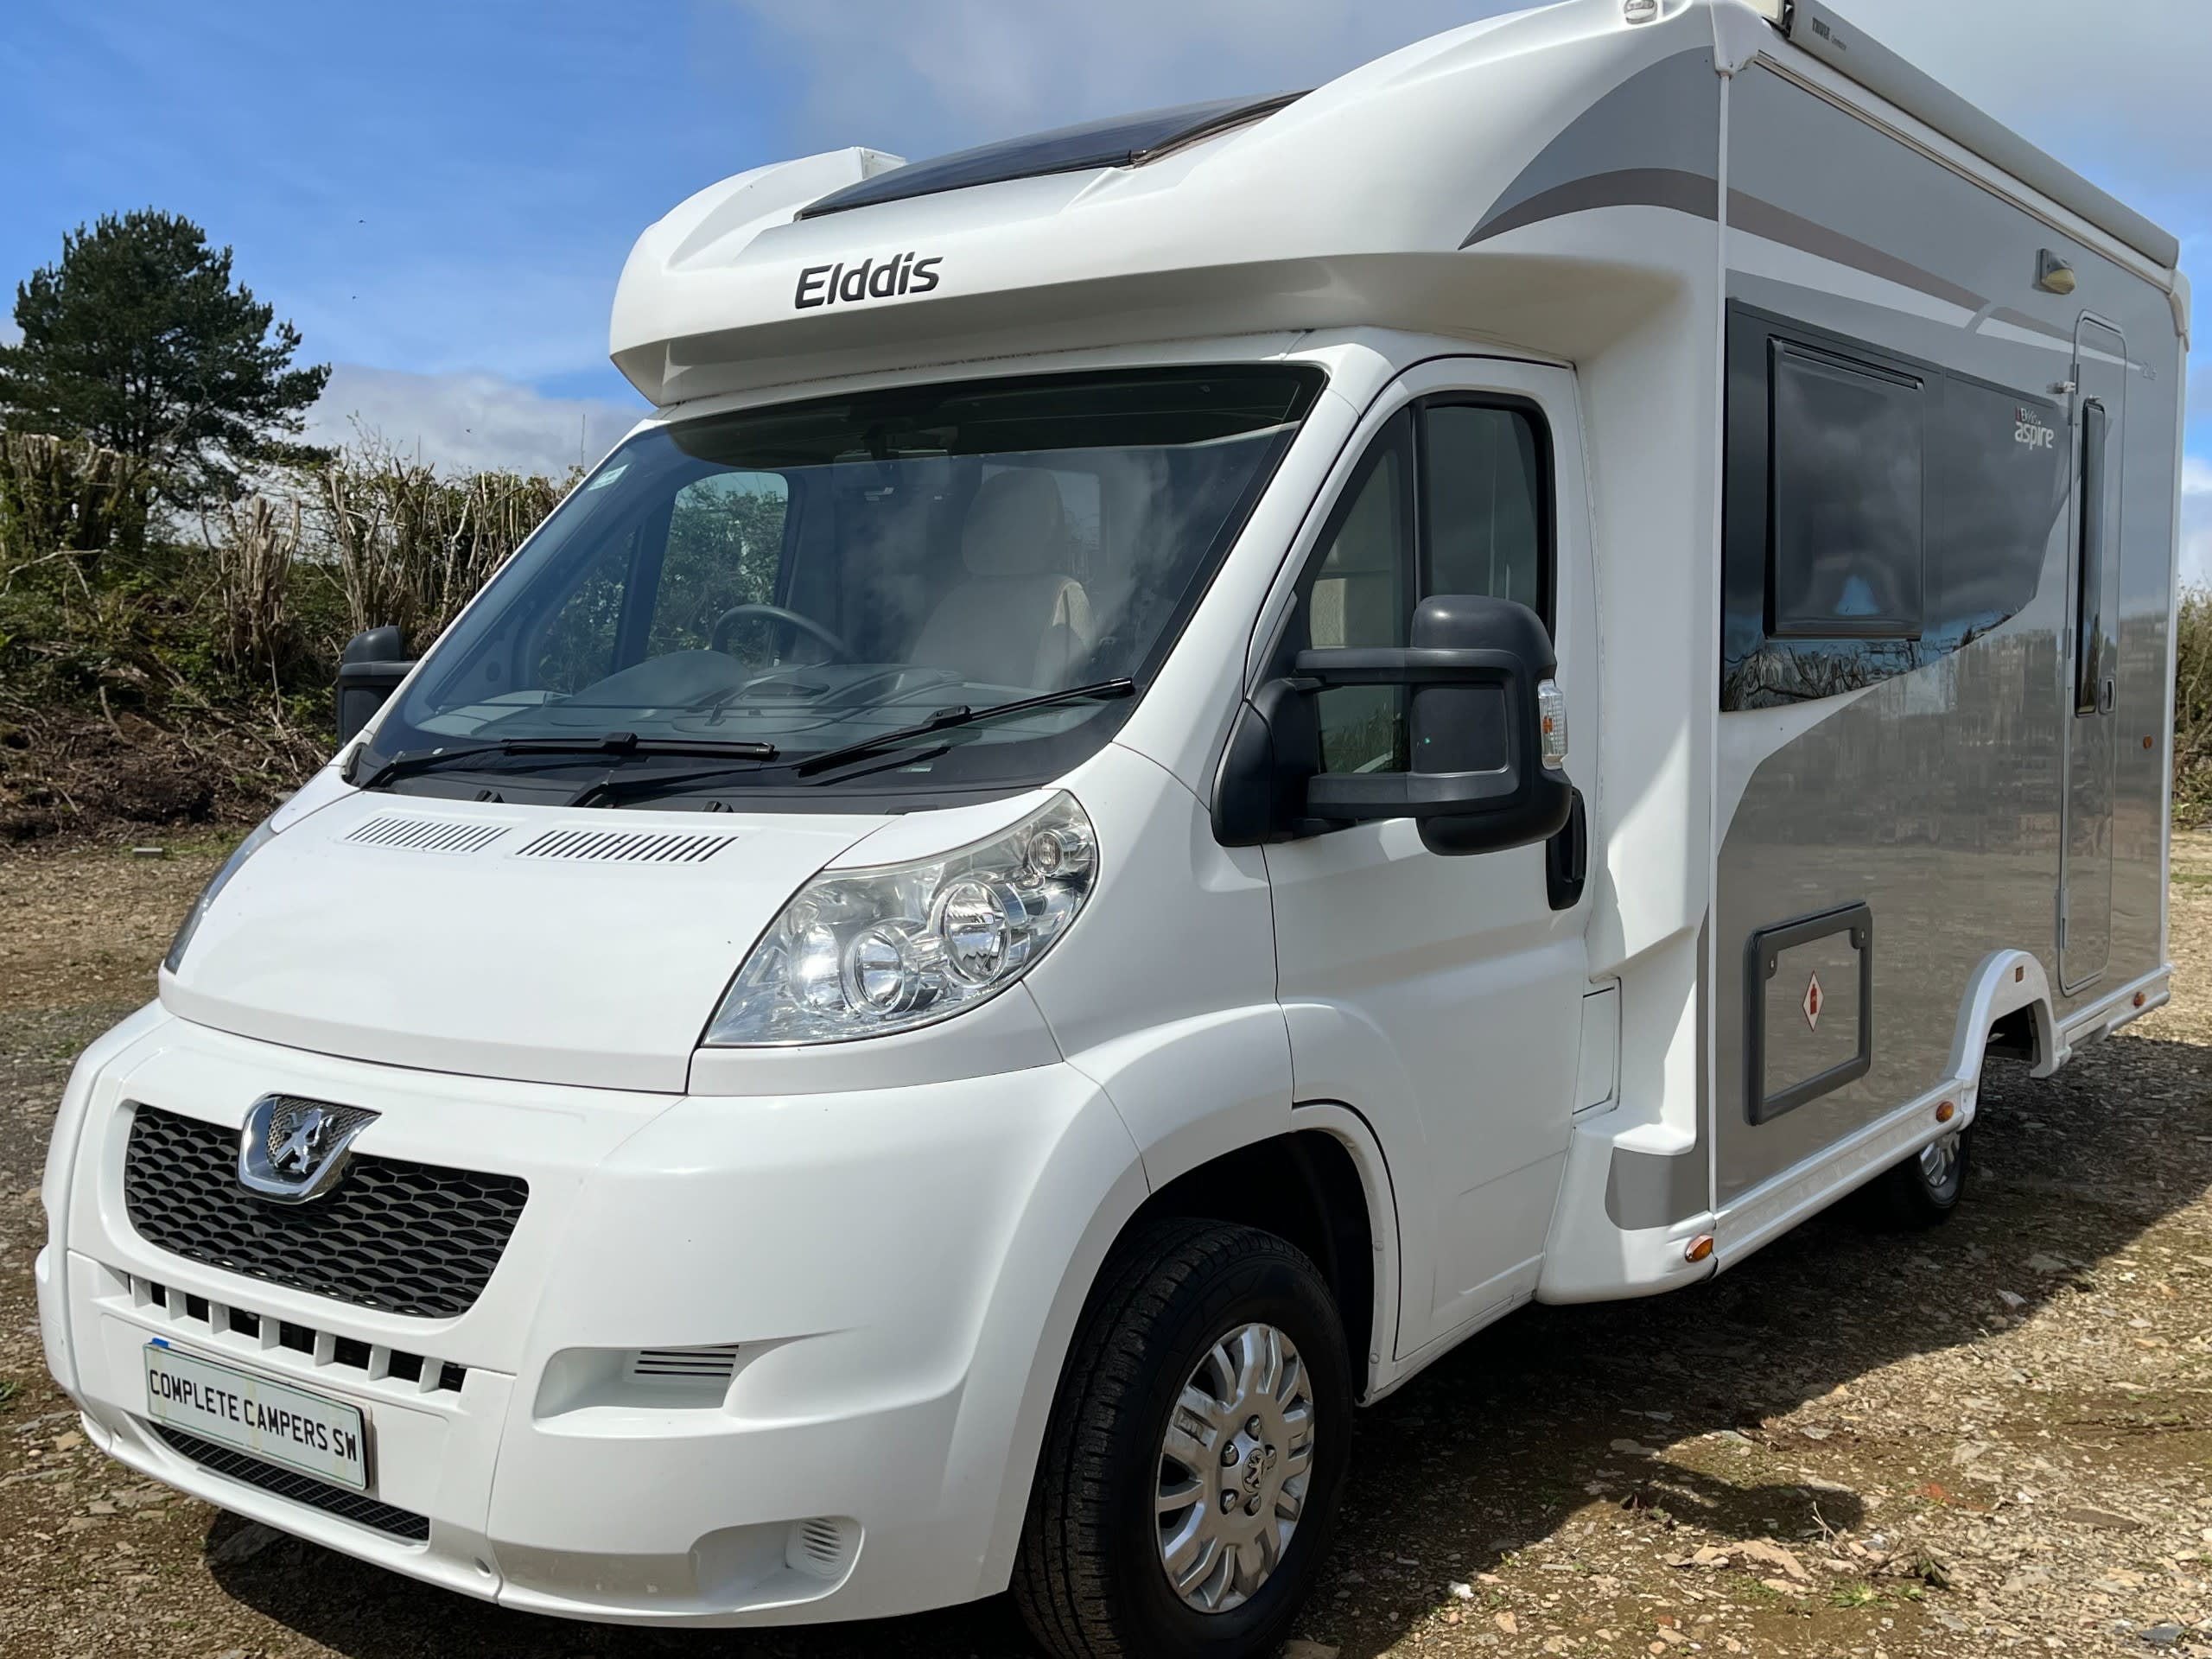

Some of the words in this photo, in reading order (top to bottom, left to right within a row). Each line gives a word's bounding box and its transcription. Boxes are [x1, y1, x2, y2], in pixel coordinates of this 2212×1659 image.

[794, 251, 944, 309] Elddis
[2014, 420, 2054, 450] aspire
[149, 1370, 240, 1421] COMPLETE
[244, 1399, 327, 1451] CAMPERS
[333, 1428, 357, 1462] SW
